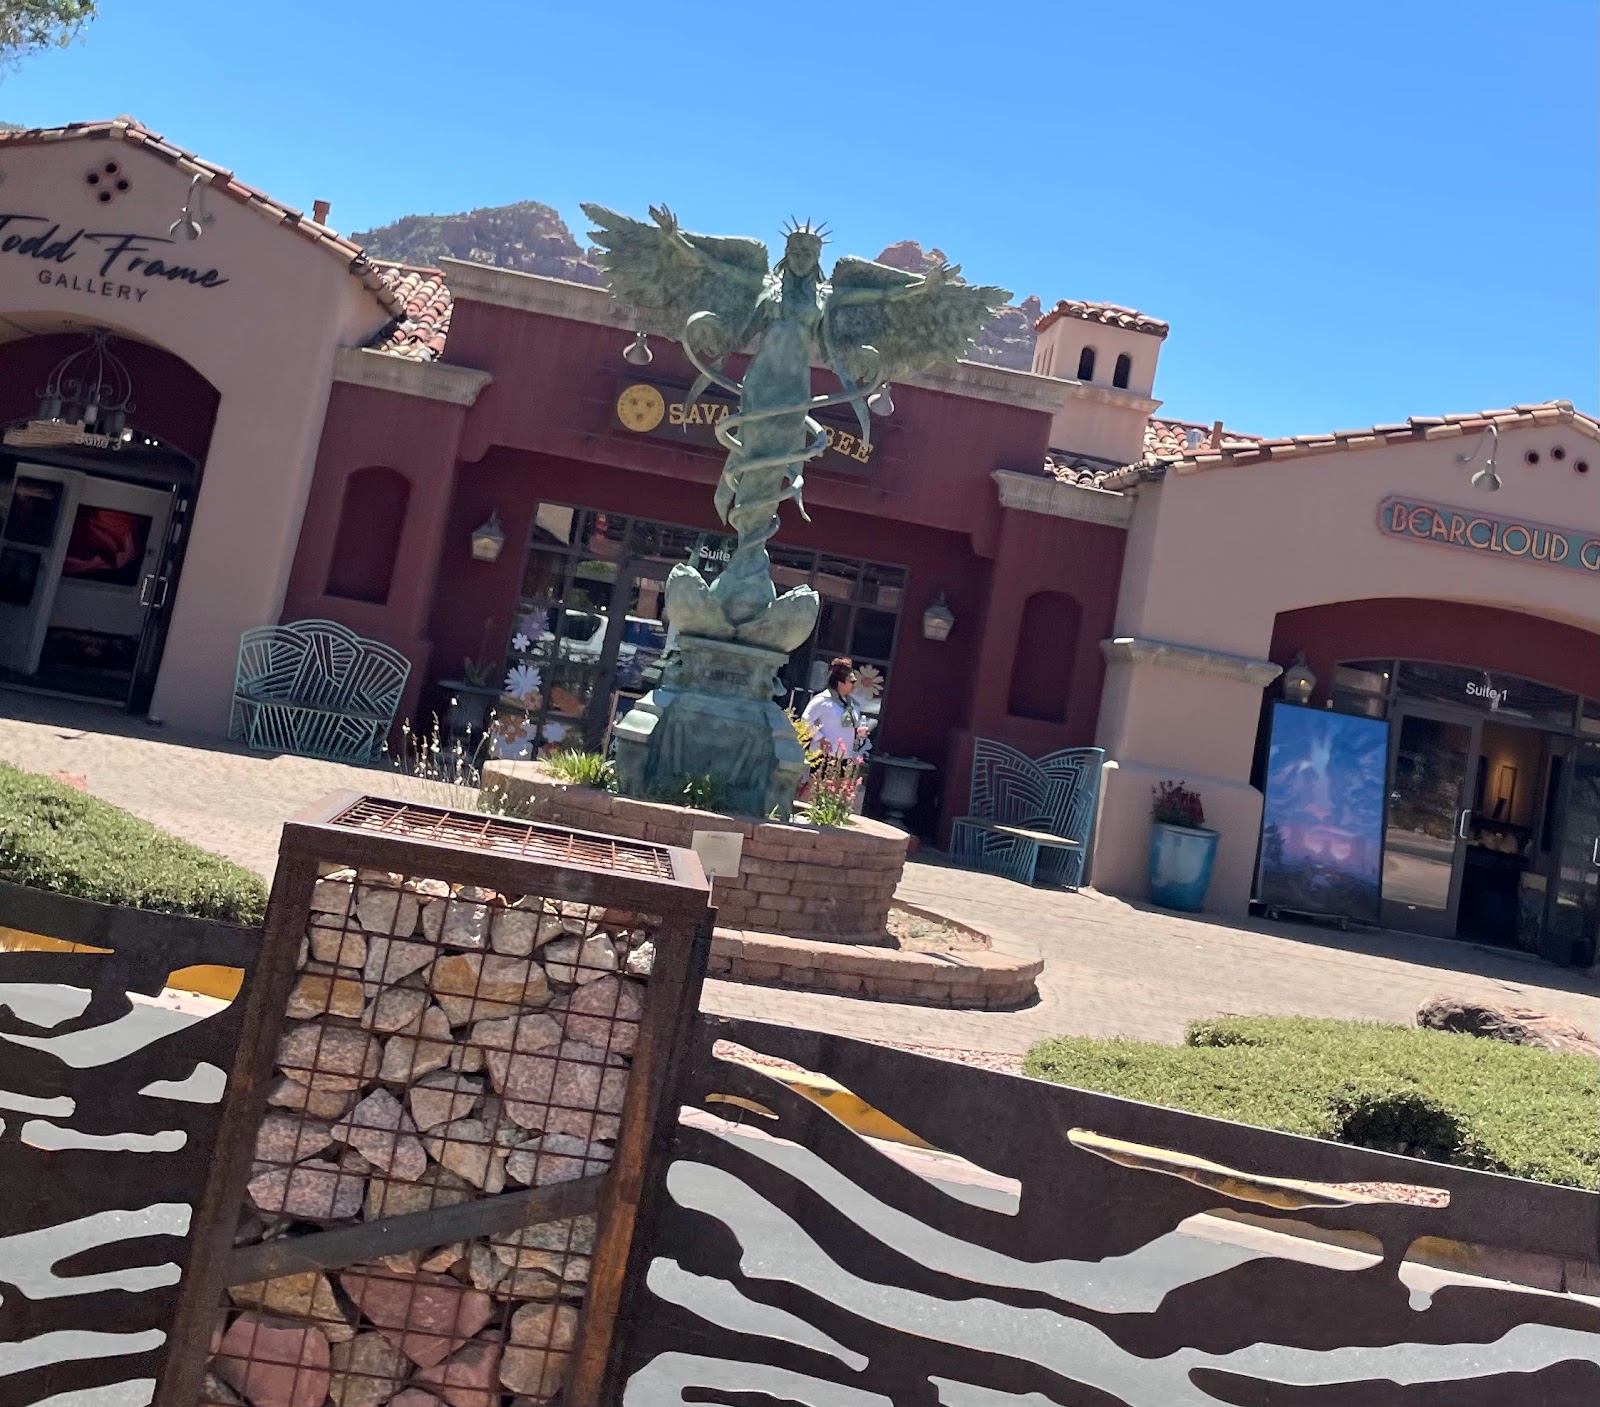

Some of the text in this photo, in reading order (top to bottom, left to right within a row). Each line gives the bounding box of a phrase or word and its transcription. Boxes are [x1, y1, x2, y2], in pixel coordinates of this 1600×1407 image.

[0, 214, 230, 288] Todd Frame
[38, 269, 149, 303] GALLERY
[669, 403, 740, 425] SAVA
[112, 437, 122, 452] 3
[1391, 503, 1569, 562] BEARCLOUD
[699, 545, 731, 562] Suite
[1465, 681, 1508, 701] Suite 1
